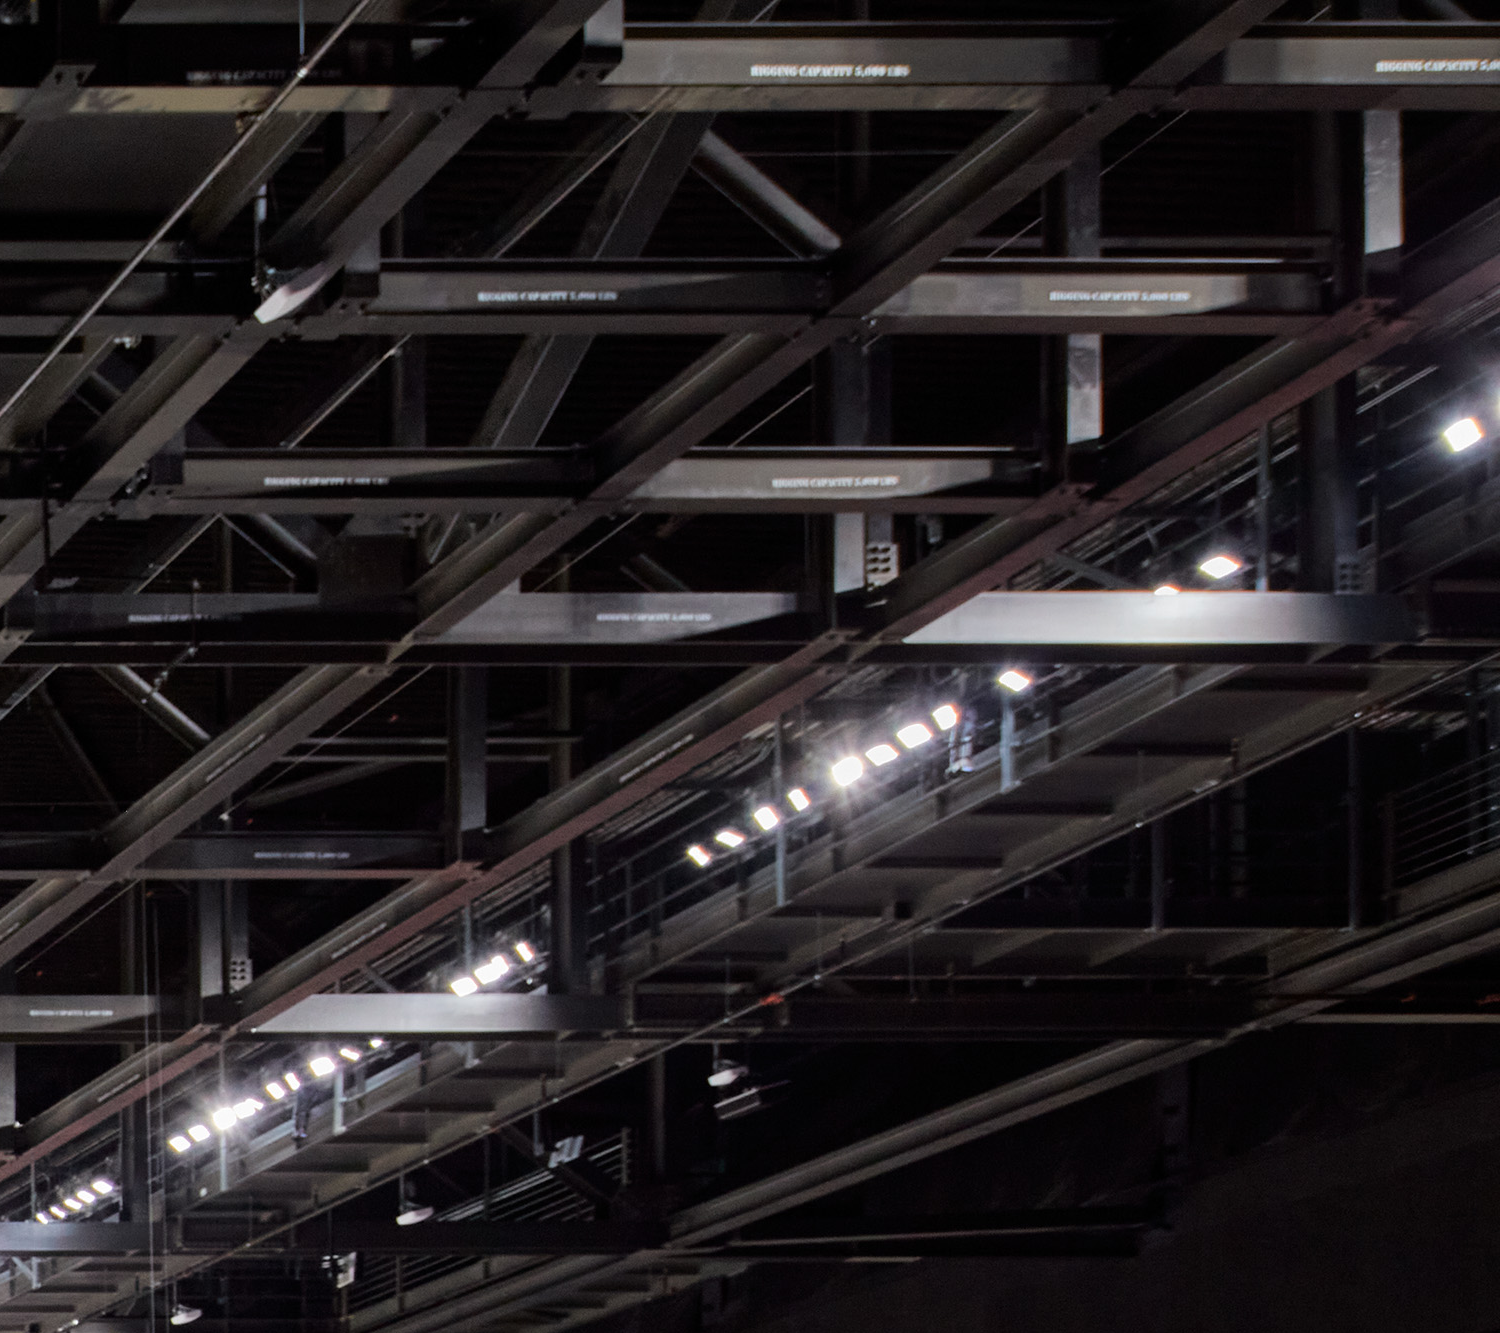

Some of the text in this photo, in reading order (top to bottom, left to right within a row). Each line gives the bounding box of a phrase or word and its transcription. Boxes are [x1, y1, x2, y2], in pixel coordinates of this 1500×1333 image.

[750, 64, 798, 77] RIGGING
[800, 64, 853, 77] CAPACITY
[1425, 60, 1478, 72] CAPACITY
